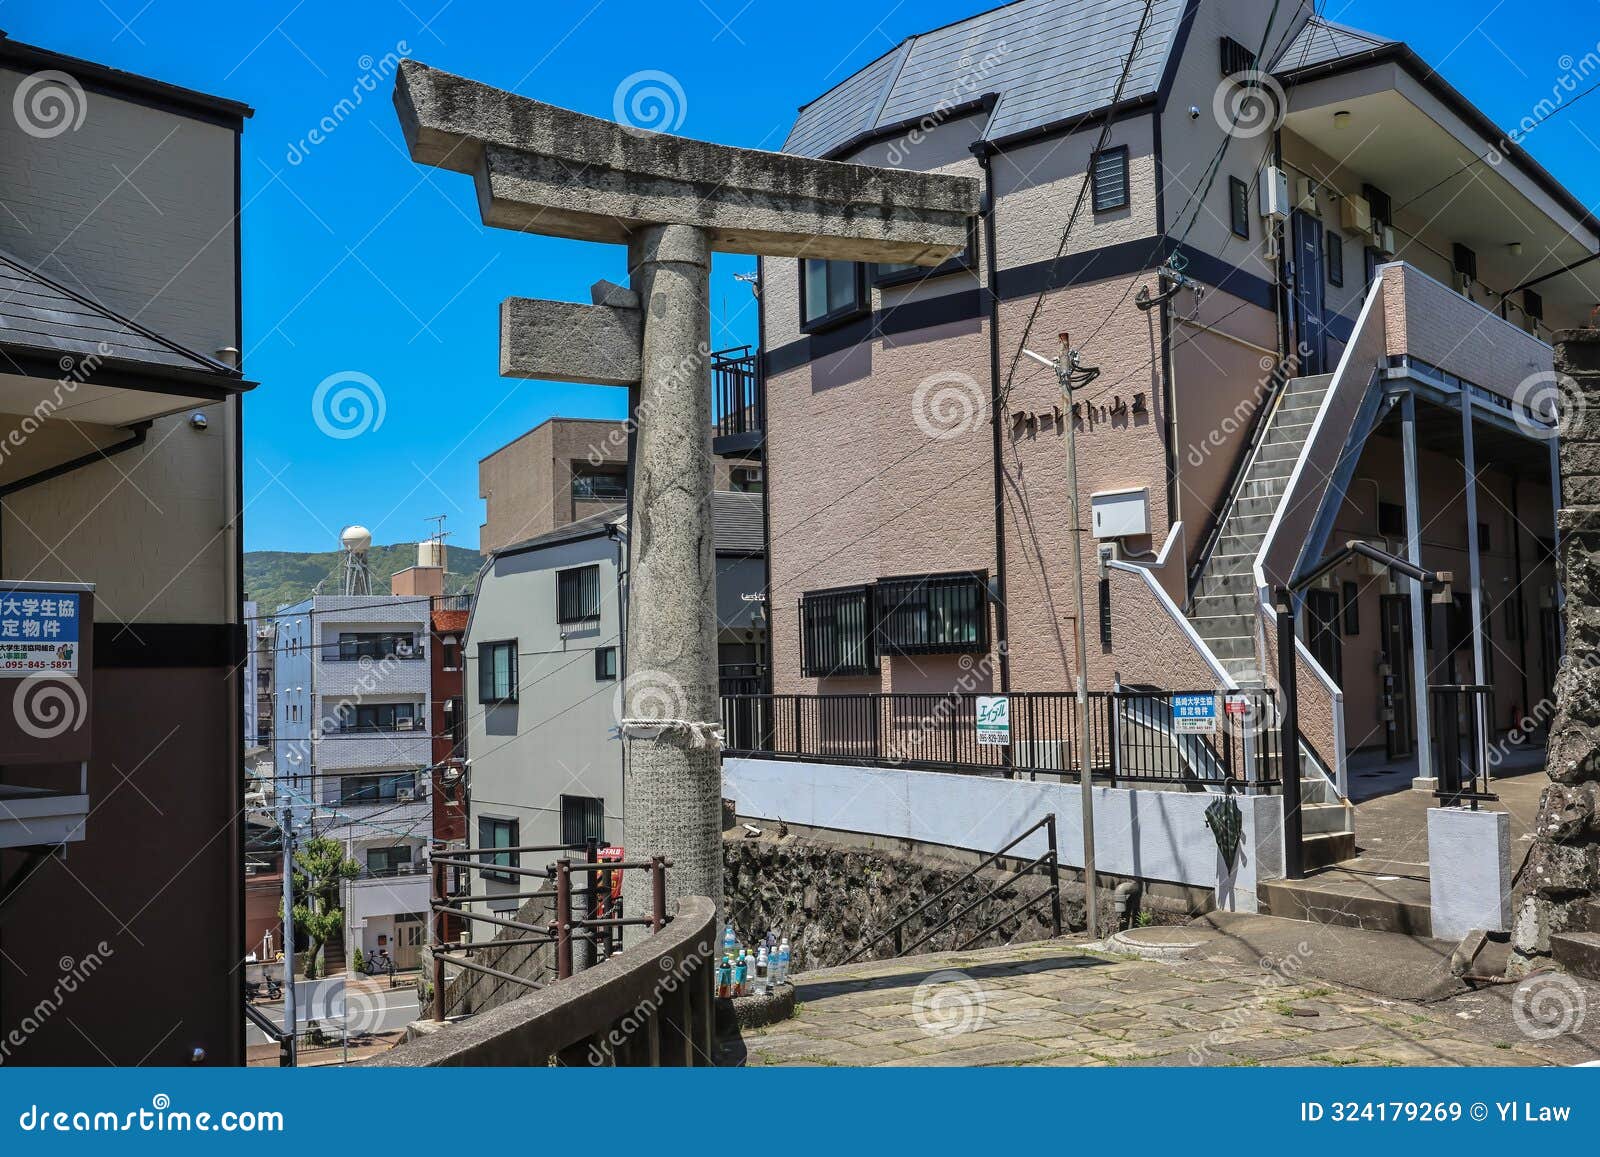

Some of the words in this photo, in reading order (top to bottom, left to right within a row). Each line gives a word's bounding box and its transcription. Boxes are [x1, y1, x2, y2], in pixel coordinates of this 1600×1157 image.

[0, 598, 75, 618] 大学生協
[1, 619, 61, 638] 定物件
[978, 699, 1007, 722] エイブル
